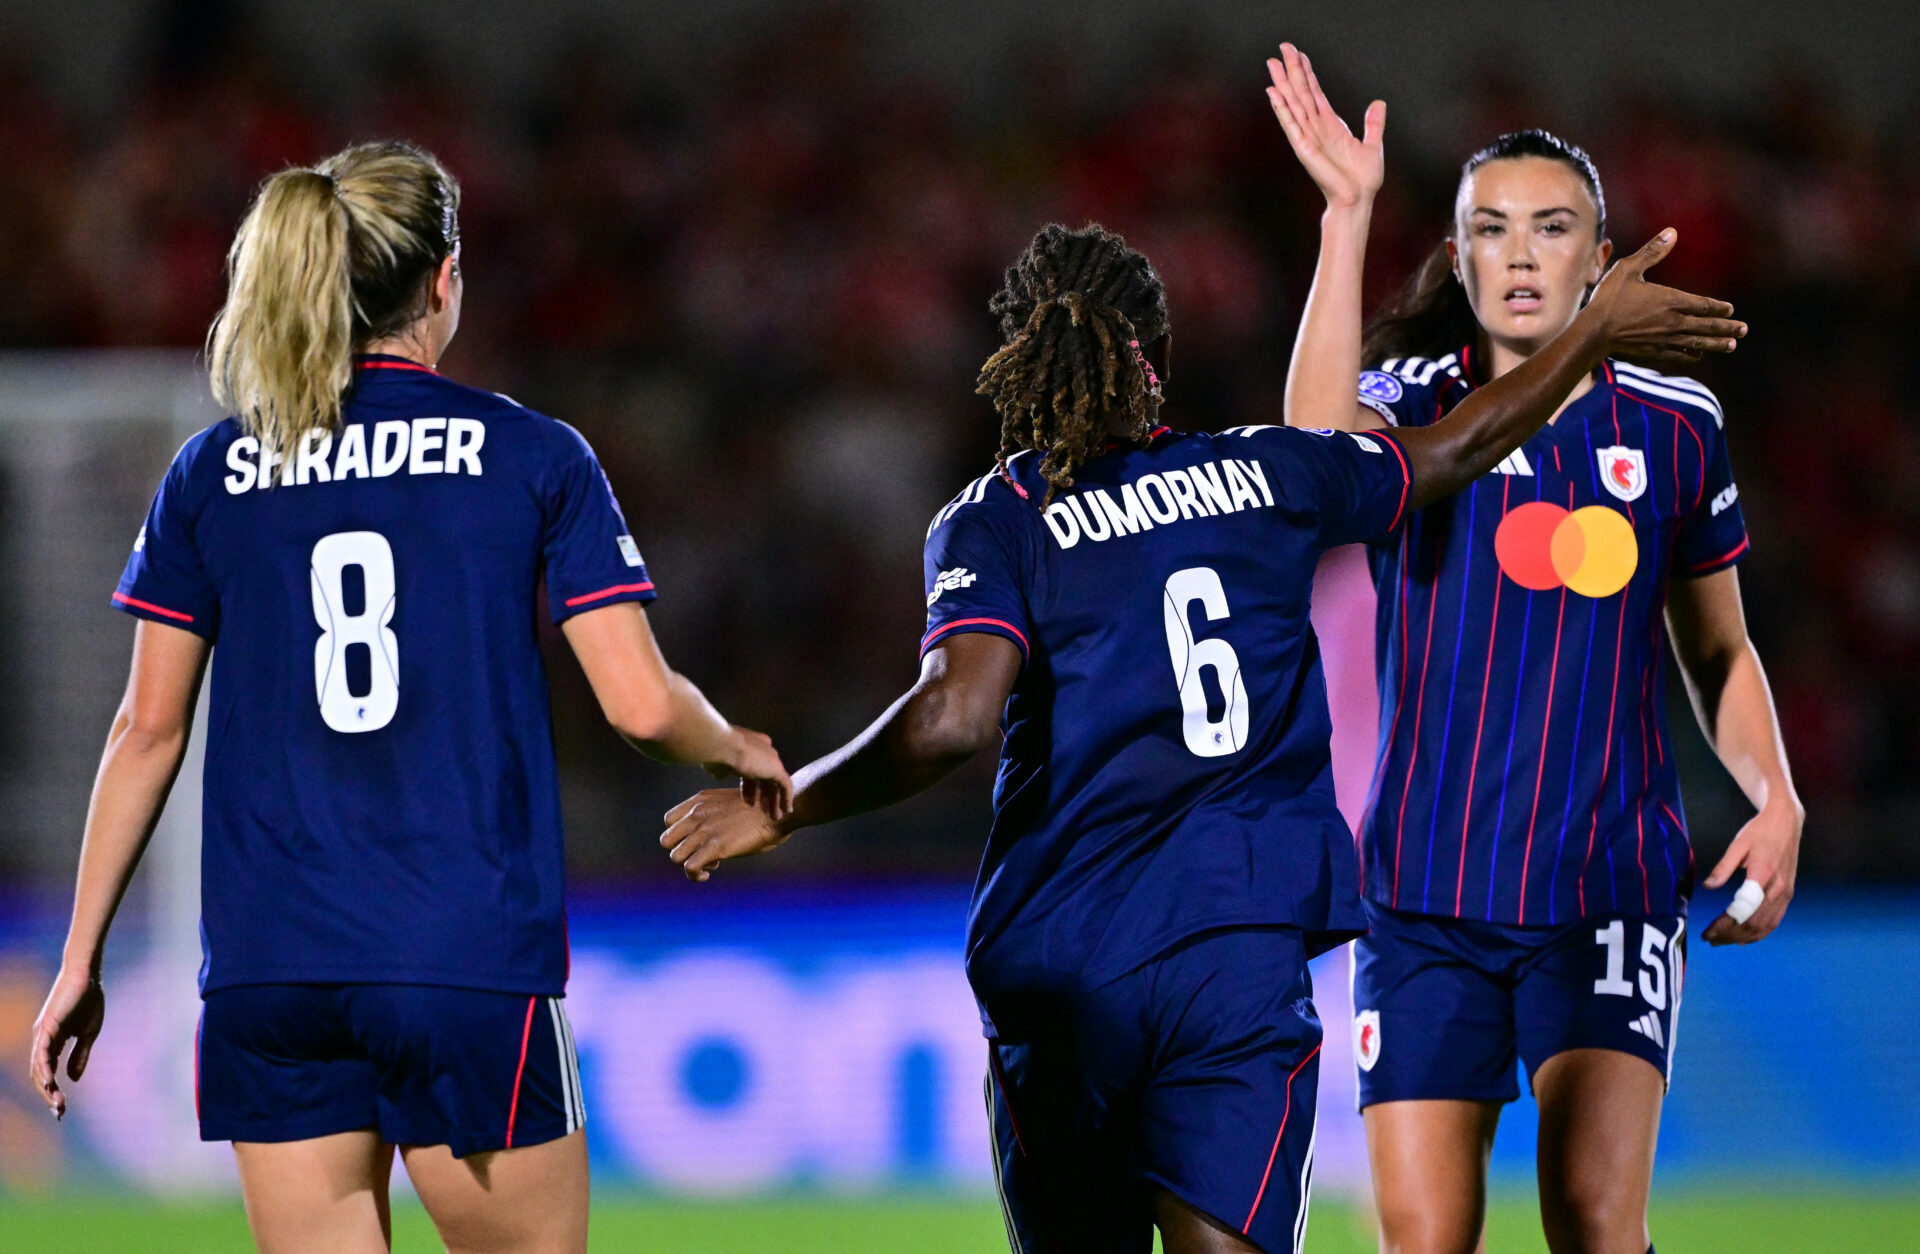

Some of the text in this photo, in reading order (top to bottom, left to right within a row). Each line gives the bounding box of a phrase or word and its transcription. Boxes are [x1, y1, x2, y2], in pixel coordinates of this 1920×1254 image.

[1042, 459, 1275, 550] DUMORNAY
[310, 531, 399, 733] 8
[1163, 566, 1250, 758] 6
[1594, 920, 1667, 1011] 15
